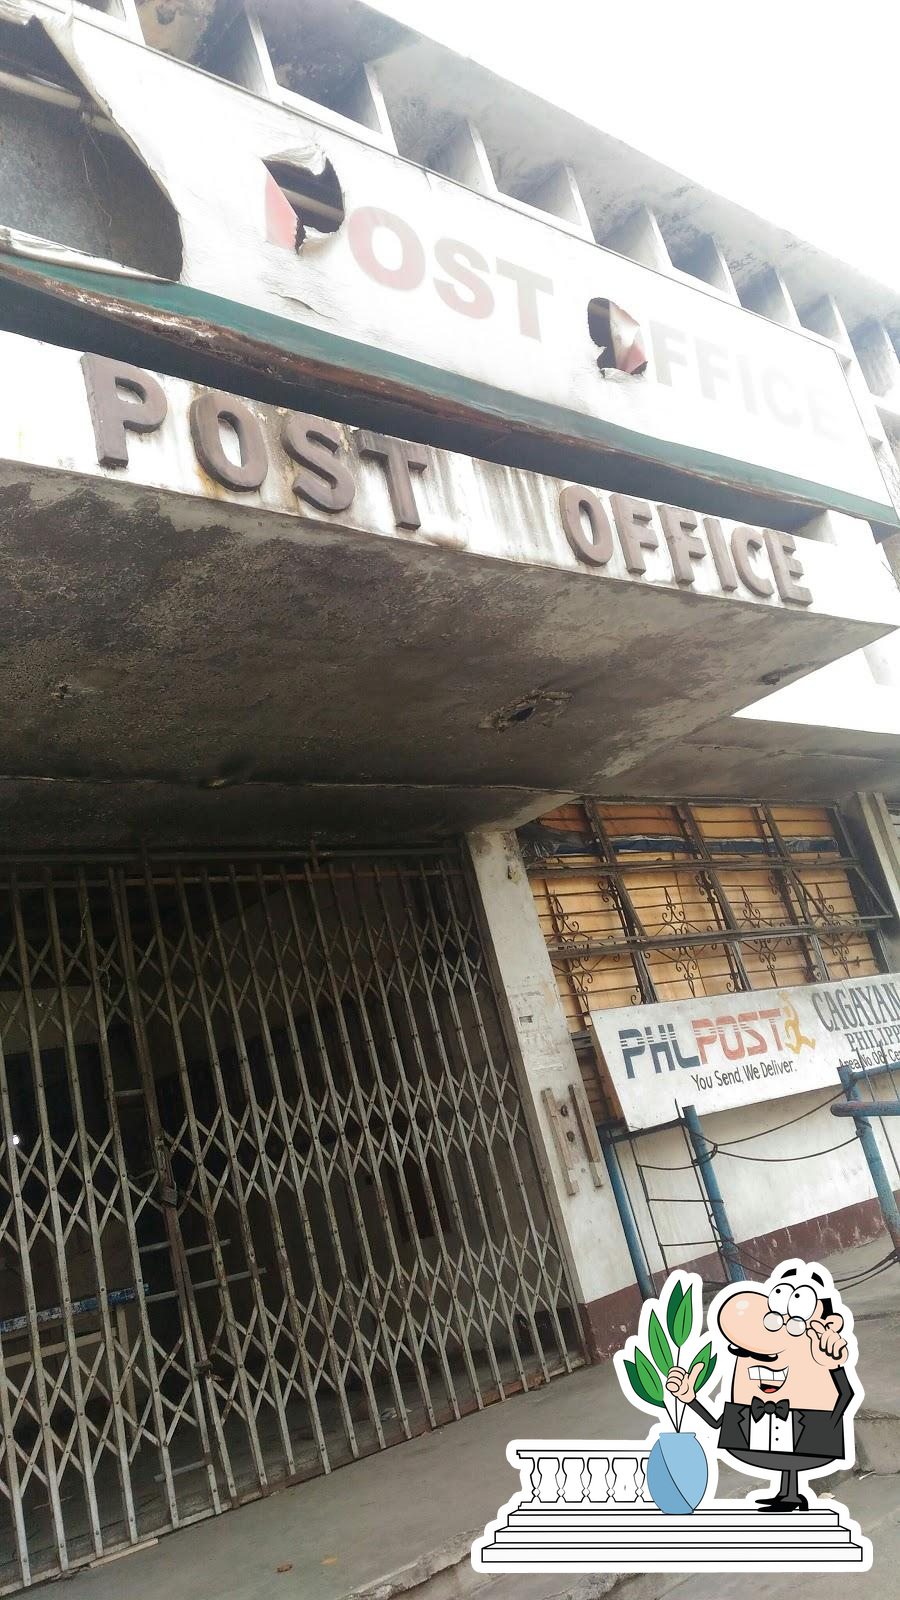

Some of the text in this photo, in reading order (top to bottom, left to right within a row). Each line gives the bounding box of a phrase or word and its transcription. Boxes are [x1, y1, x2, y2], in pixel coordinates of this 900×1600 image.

[587, 297, 845, 443] FFICE
[80, 352, 813, 606] POST OFFICE
[811, 982, 900, 1032] CAGAYAN
[844, 1024, 900, 1052] PHILIPP
[888, 1048, 900, 1062] Ce
[691, 1060, 798, 1091] You Send, We Deliver.
